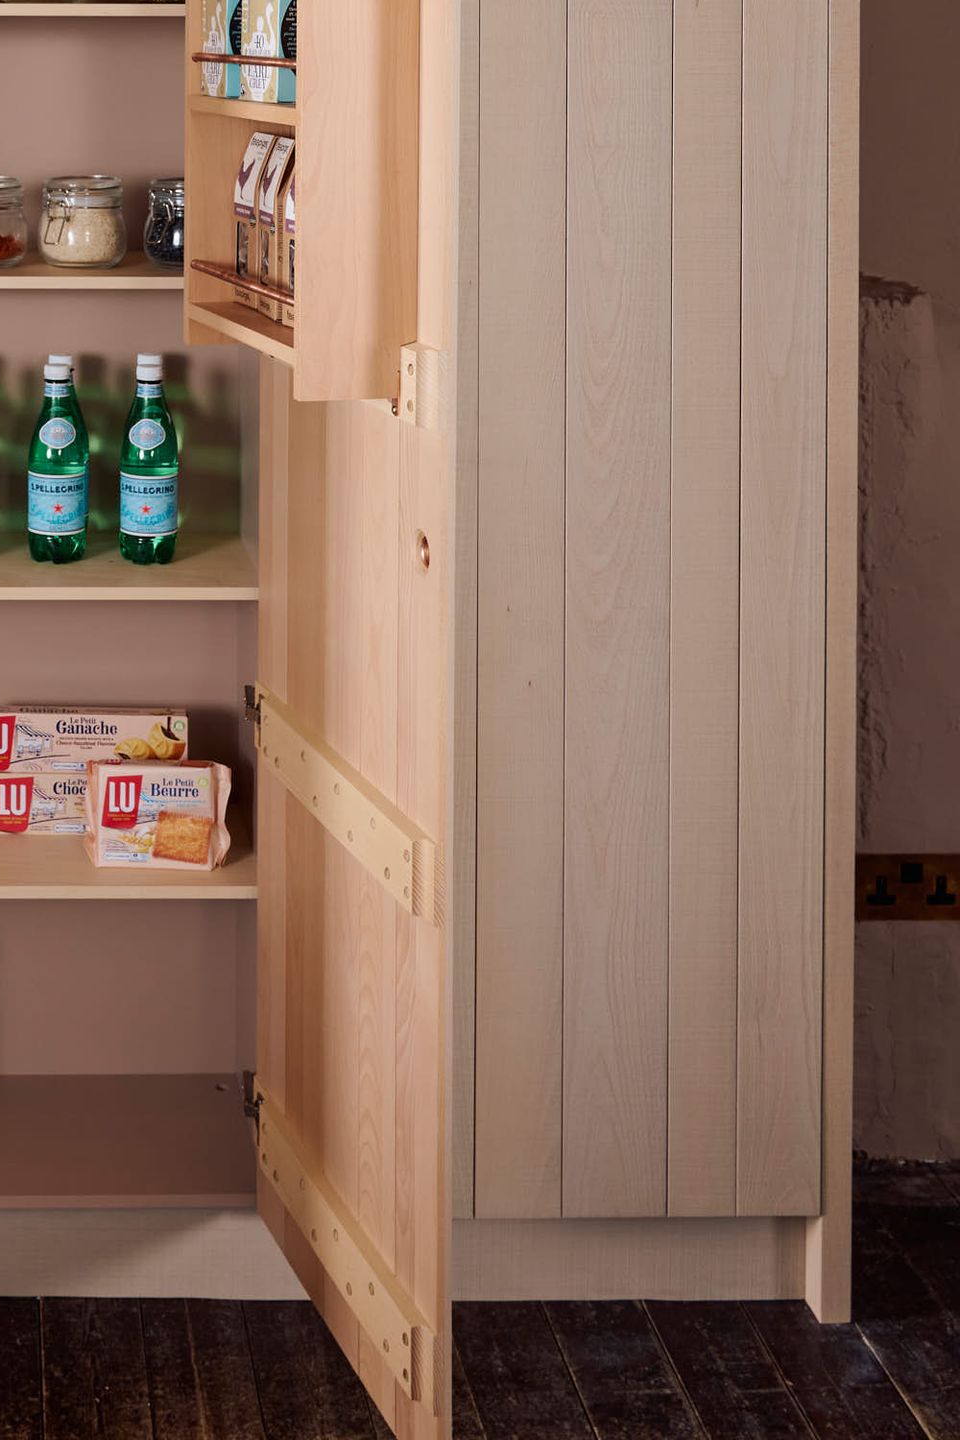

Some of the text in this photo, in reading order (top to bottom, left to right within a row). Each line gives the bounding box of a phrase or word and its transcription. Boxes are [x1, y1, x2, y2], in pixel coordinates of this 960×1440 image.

[55, 720, 118, 735] Ganache
[175, 778, 194, 787] Petit
[108, 781, 136, 813] LU
[150, 783, 199, 798] Beurre
[0, 784, 27, 815] LU
